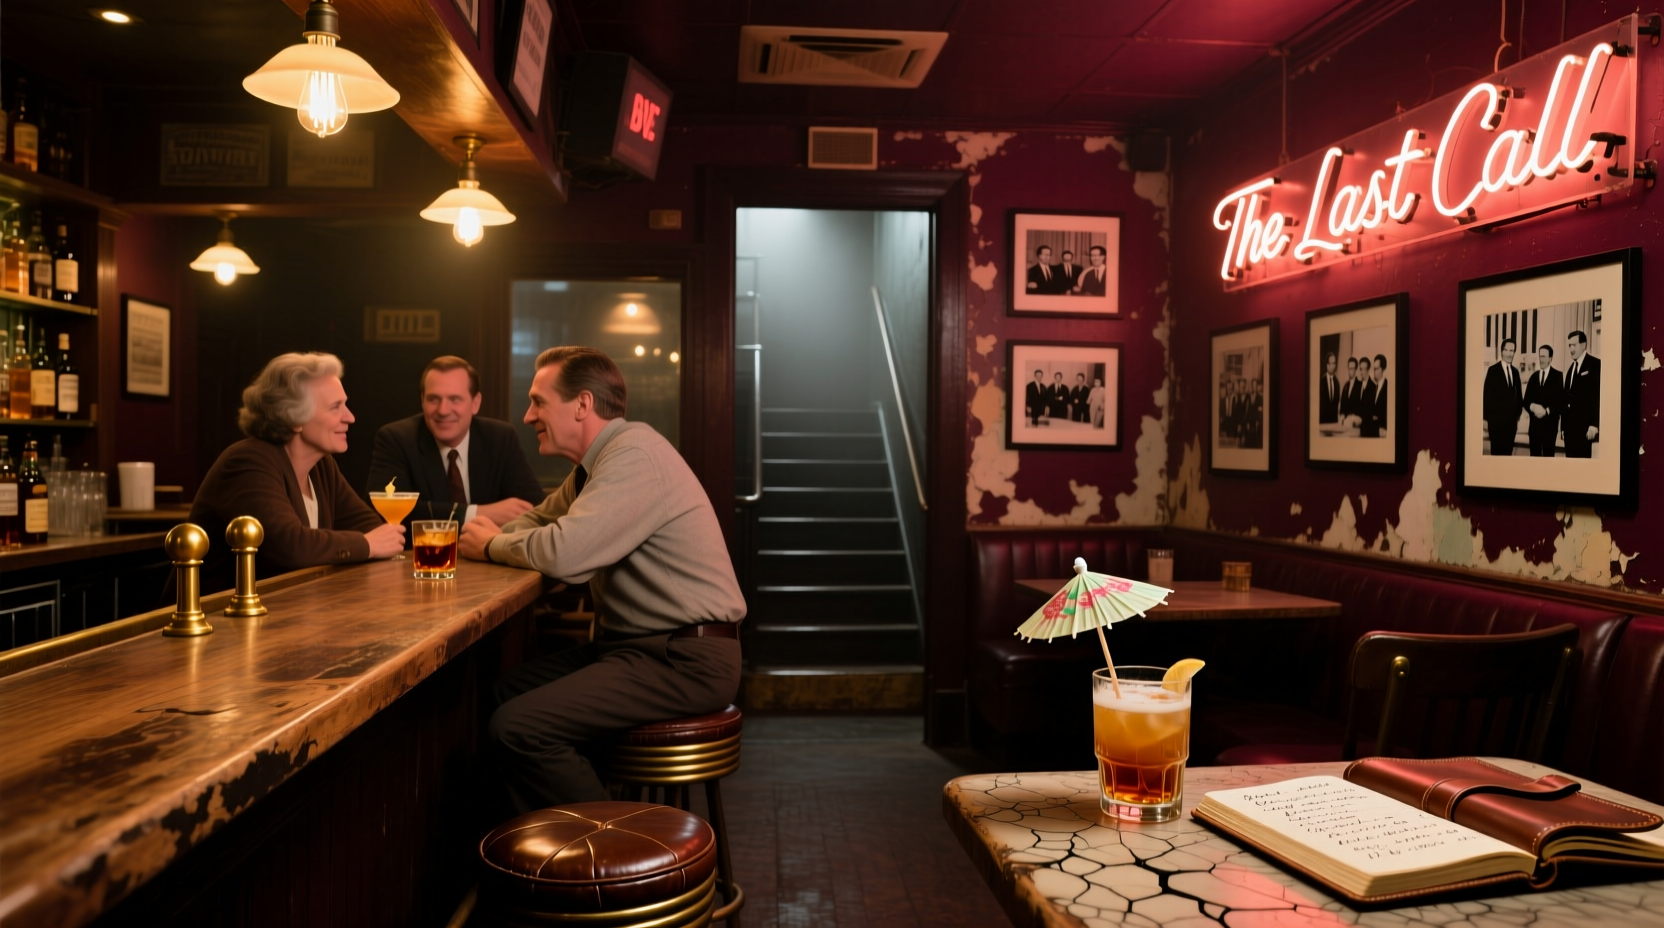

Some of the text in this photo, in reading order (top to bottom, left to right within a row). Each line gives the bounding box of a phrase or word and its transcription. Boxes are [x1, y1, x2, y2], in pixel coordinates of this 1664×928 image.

[1213, 43, 1612, 281] The Last Call
